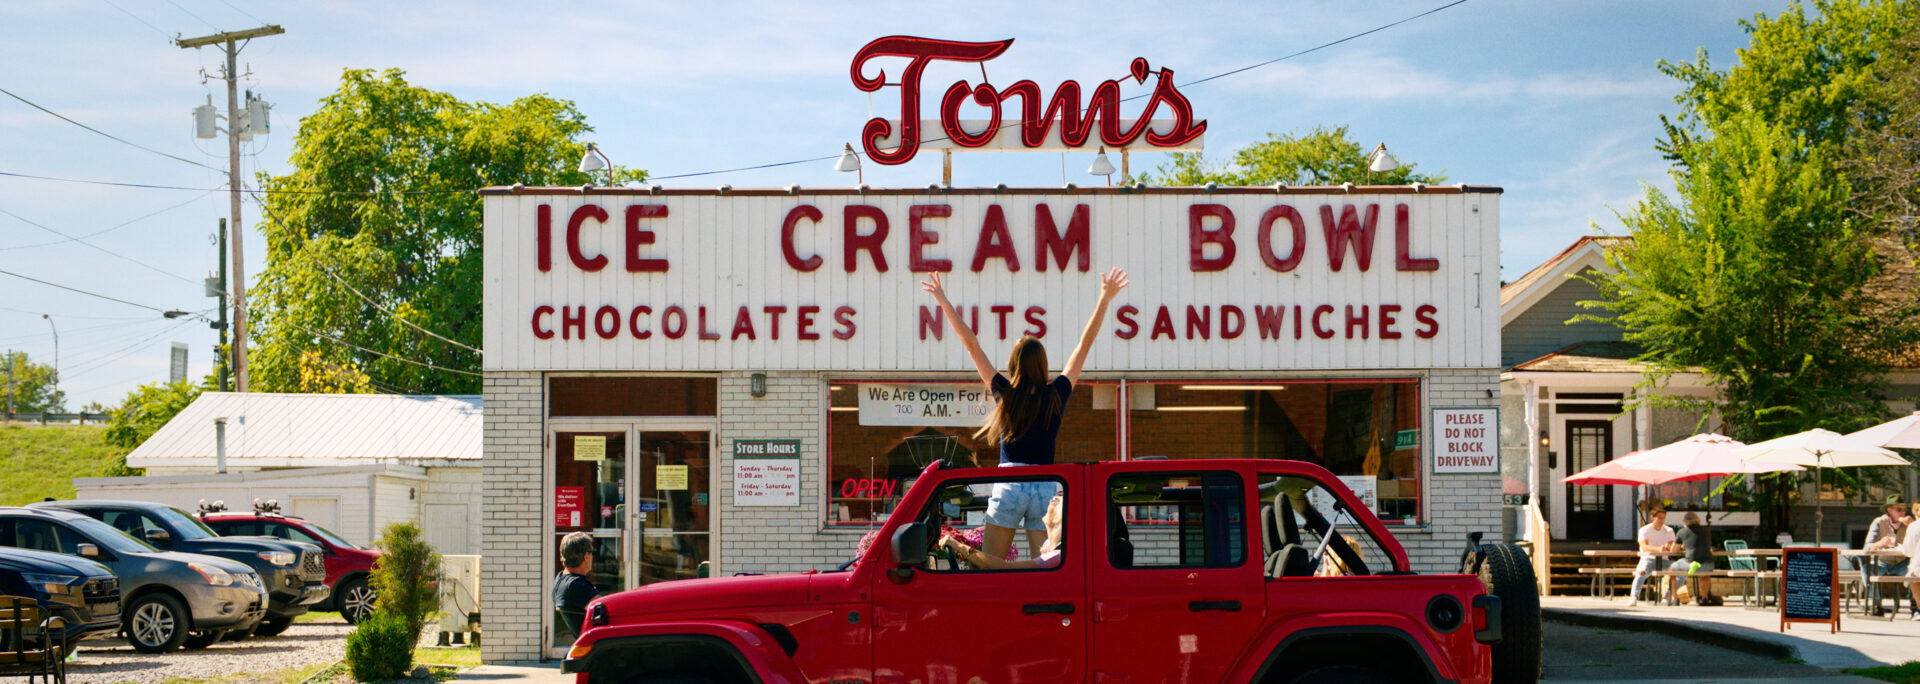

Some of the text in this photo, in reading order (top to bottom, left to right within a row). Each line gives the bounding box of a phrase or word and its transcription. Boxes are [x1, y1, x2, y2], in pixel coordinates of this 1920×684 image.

[850, 35, 1206, 165] Tom's
[537, 204, 1439, 272] ICE CREAM BOWL
[532, 305, 856, 340] CHOCOLATES
[1115, 304, 1439, 340] SANDWICHES
[868, 387, 889, 401] We
[893, 387, 915, 401] Are
[919, 389, 954, 405] Open
[958, 389, 981, 401] For
[922, 404, 952, 417] A.M.
[1445, 413, 1485, 425] PLEASE
[1445, 427, 1486, 439] DO NOT
[1447, 441, 1484, 453] BLOCK
[1437, 455, 1494, 467] DRIVEWAY
[841, 478, 897, 498] OPEN
